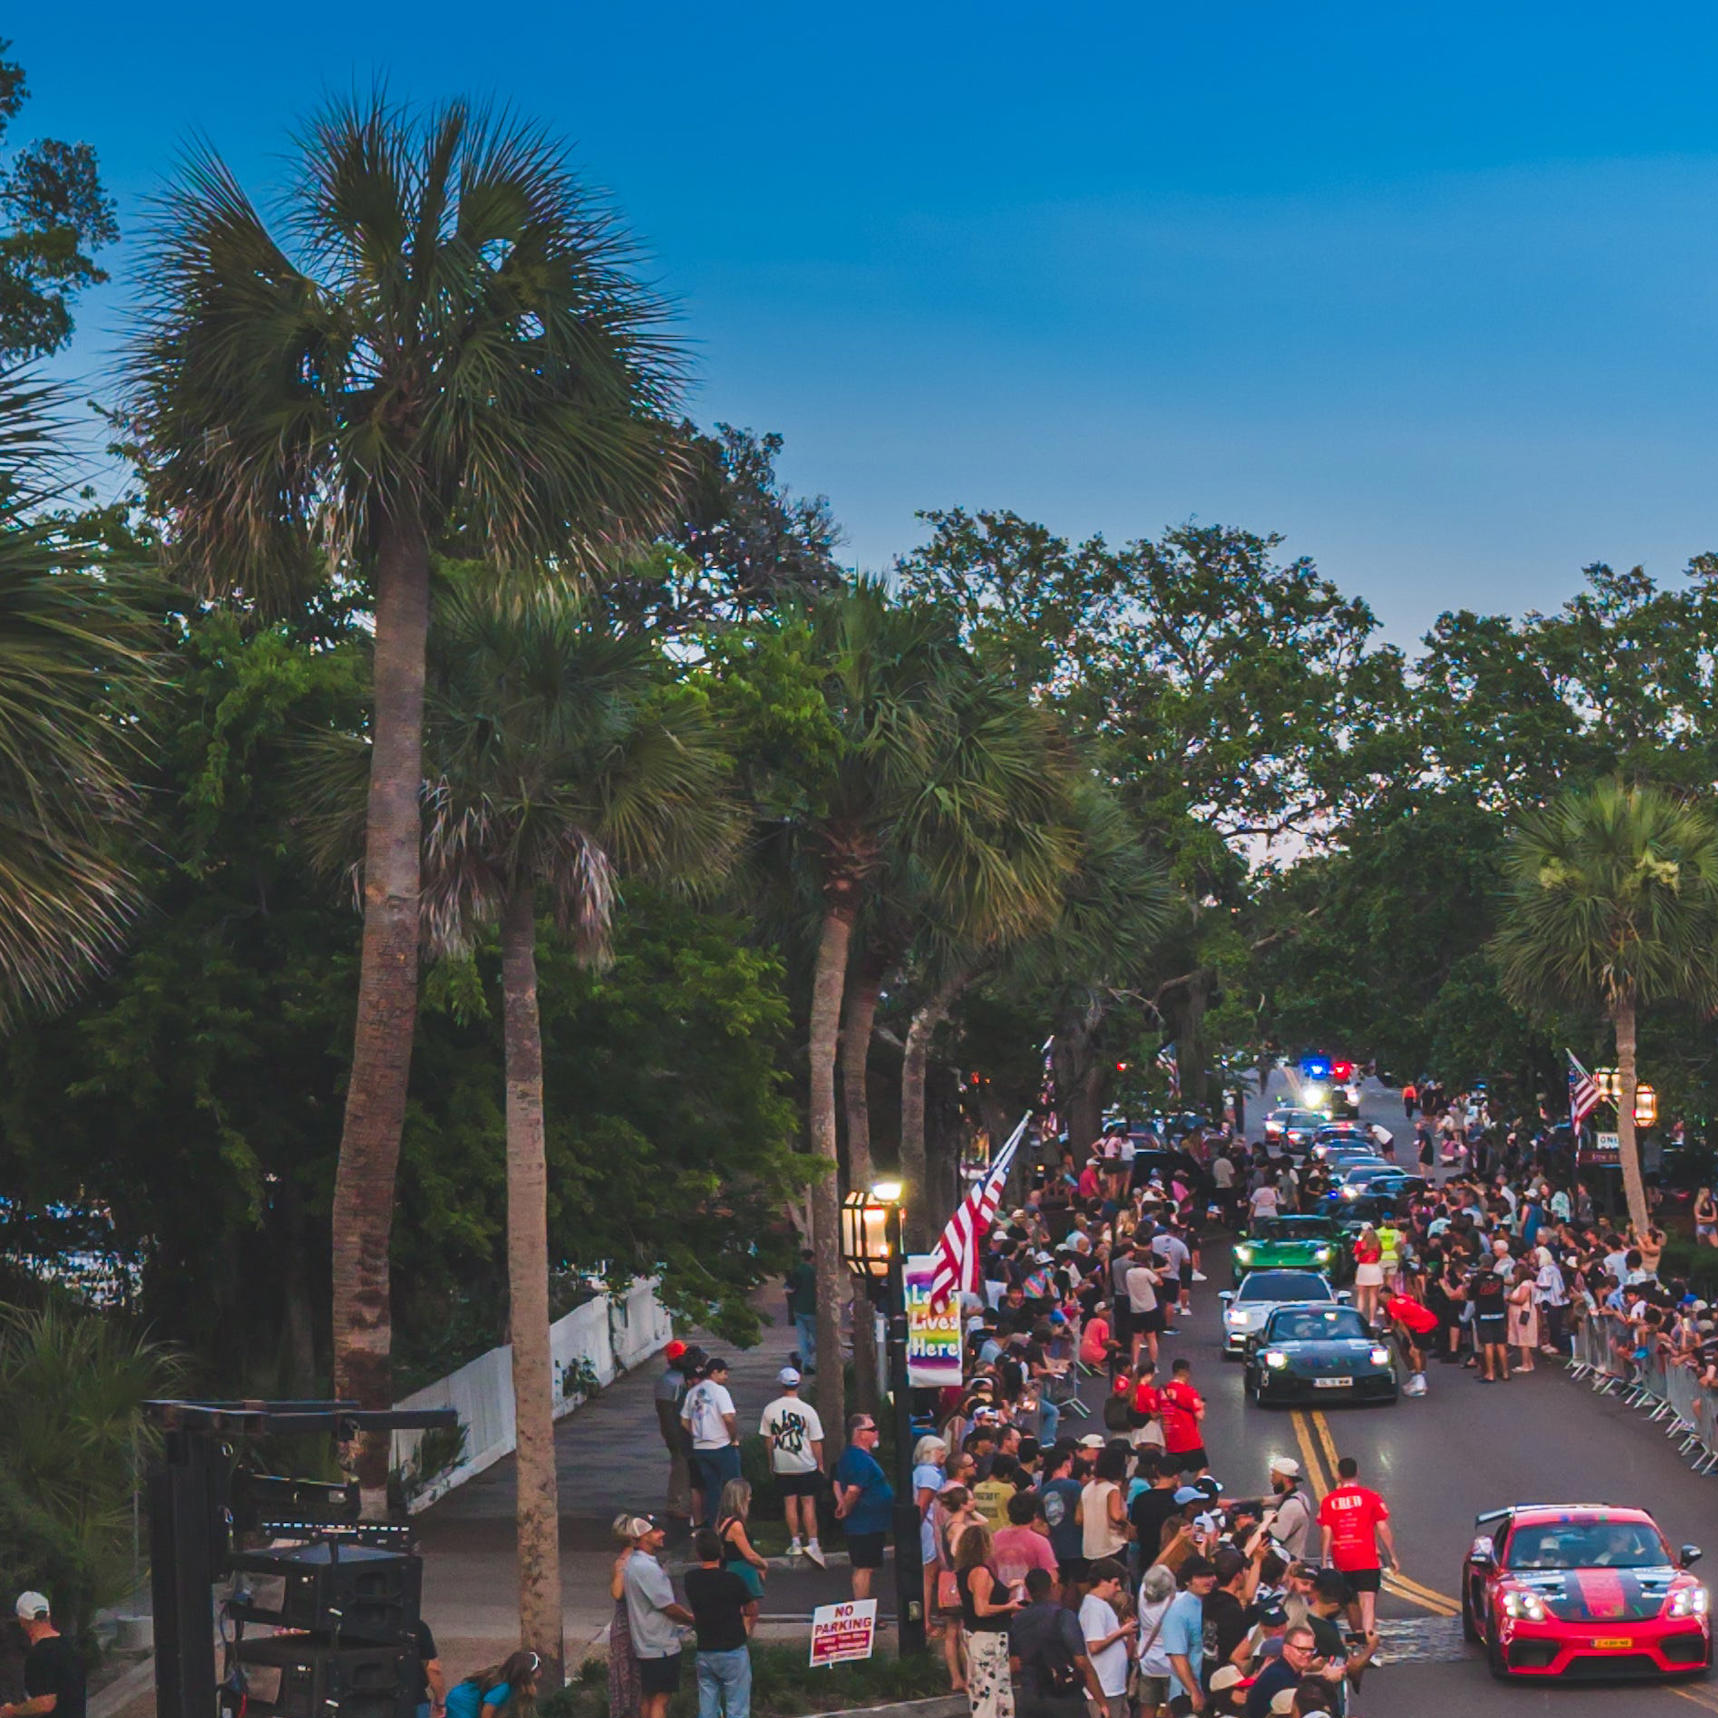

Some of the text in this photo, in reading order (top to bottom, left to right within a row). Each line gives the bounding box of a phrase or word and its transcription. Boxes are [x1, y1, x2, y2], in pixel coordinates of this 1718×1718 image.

[911, 1311, 959, 1331] Lives
[911, 1338, 959, 1357] Here
[834, 1604, 854, 1618] NO
[814, 1616, 872, 1635] PARKING
